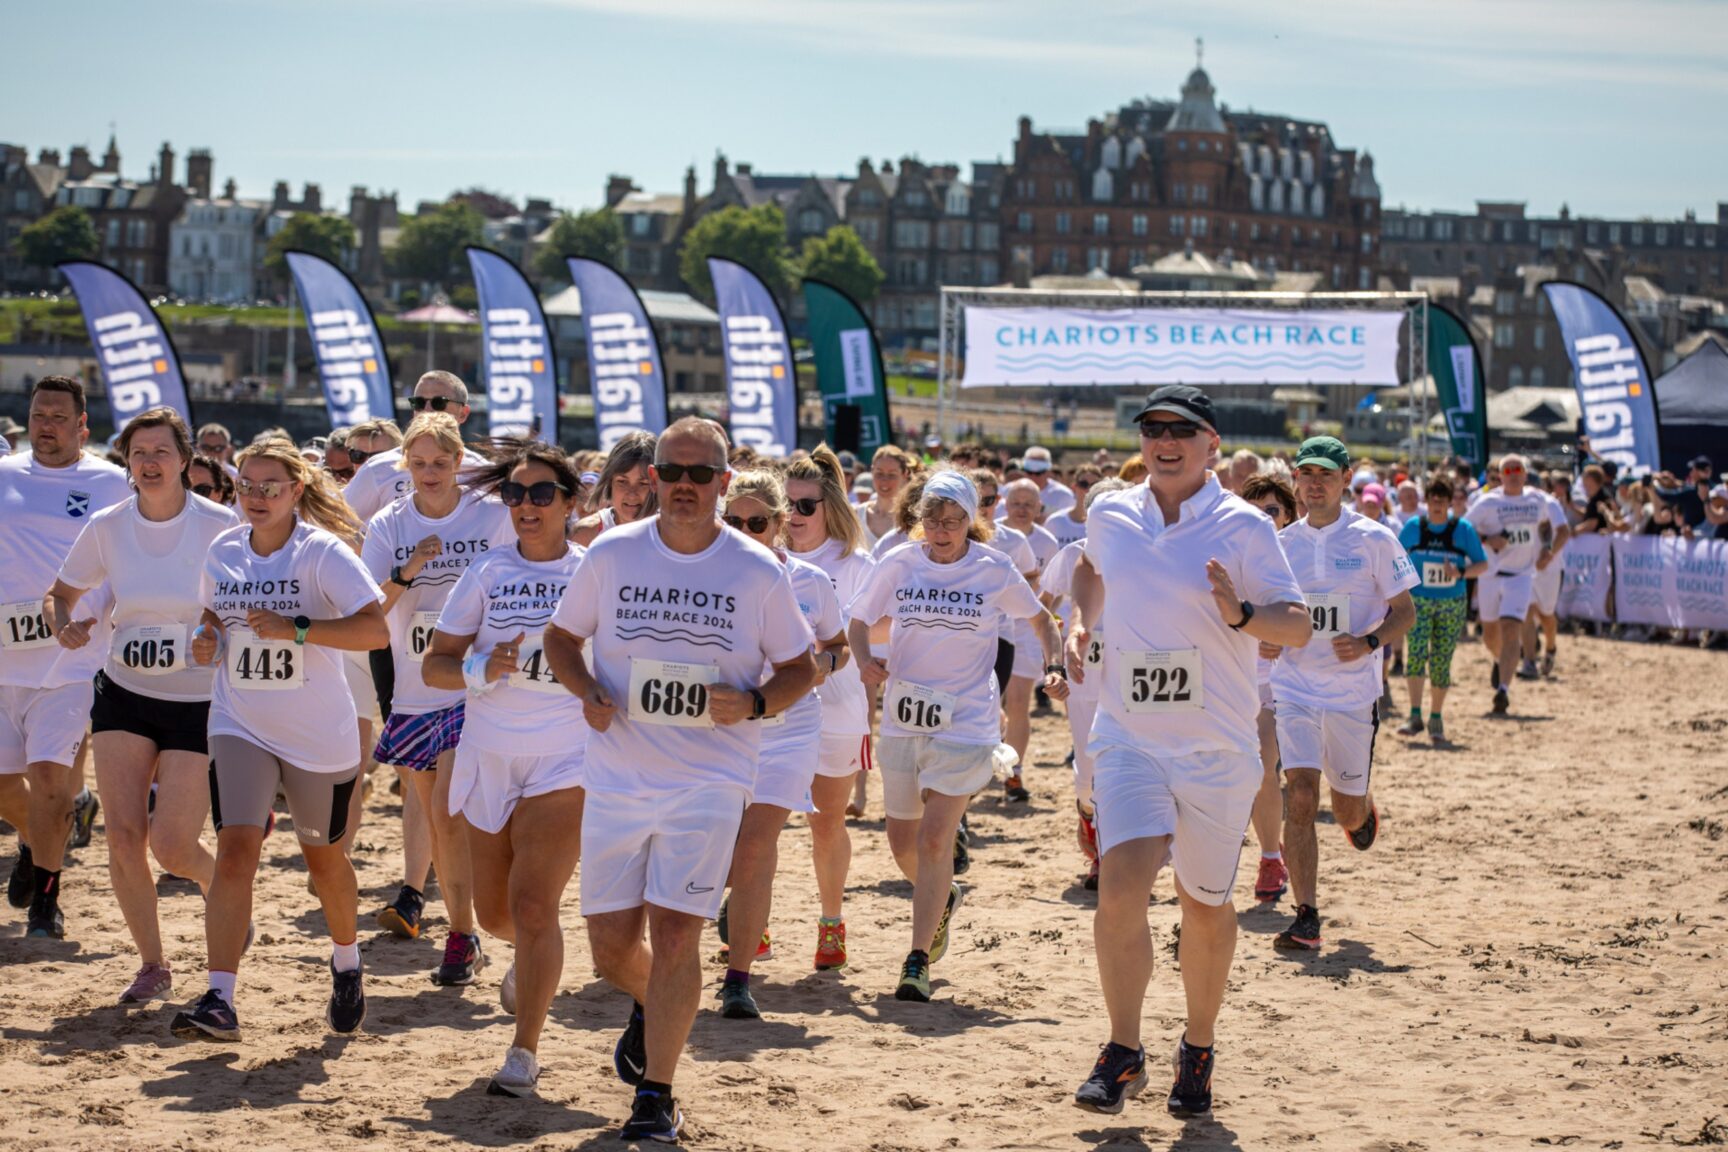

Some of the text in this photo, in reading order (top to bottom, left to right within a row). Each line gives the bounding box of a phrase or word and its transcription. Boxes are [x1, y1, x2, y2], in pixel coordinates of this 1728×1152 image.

[1169, 325, 1272, 345] BEACH
[1286, 325, 1366, 345] RACE
[432, 559, 461, 570] RACE
[240, 601, 268, 610] RACE
[272, 600, 300, 610] 2024
[490, 600, 557, 612] BEACH RAC
[925, 605, 954, 615] RACE
[957, 607, 982, 618] 2024
[616, 608, 733, 630] BEACH RACE 2024
[1308, 606, 1339, 632] 91
[123, 639, 175, 669] 605
[236, 647, 294, 681] 443
[1132, 667, 1191, 702] 522
[641, 678, 707, 718] 689
[897, 696, 942, 728] 616
